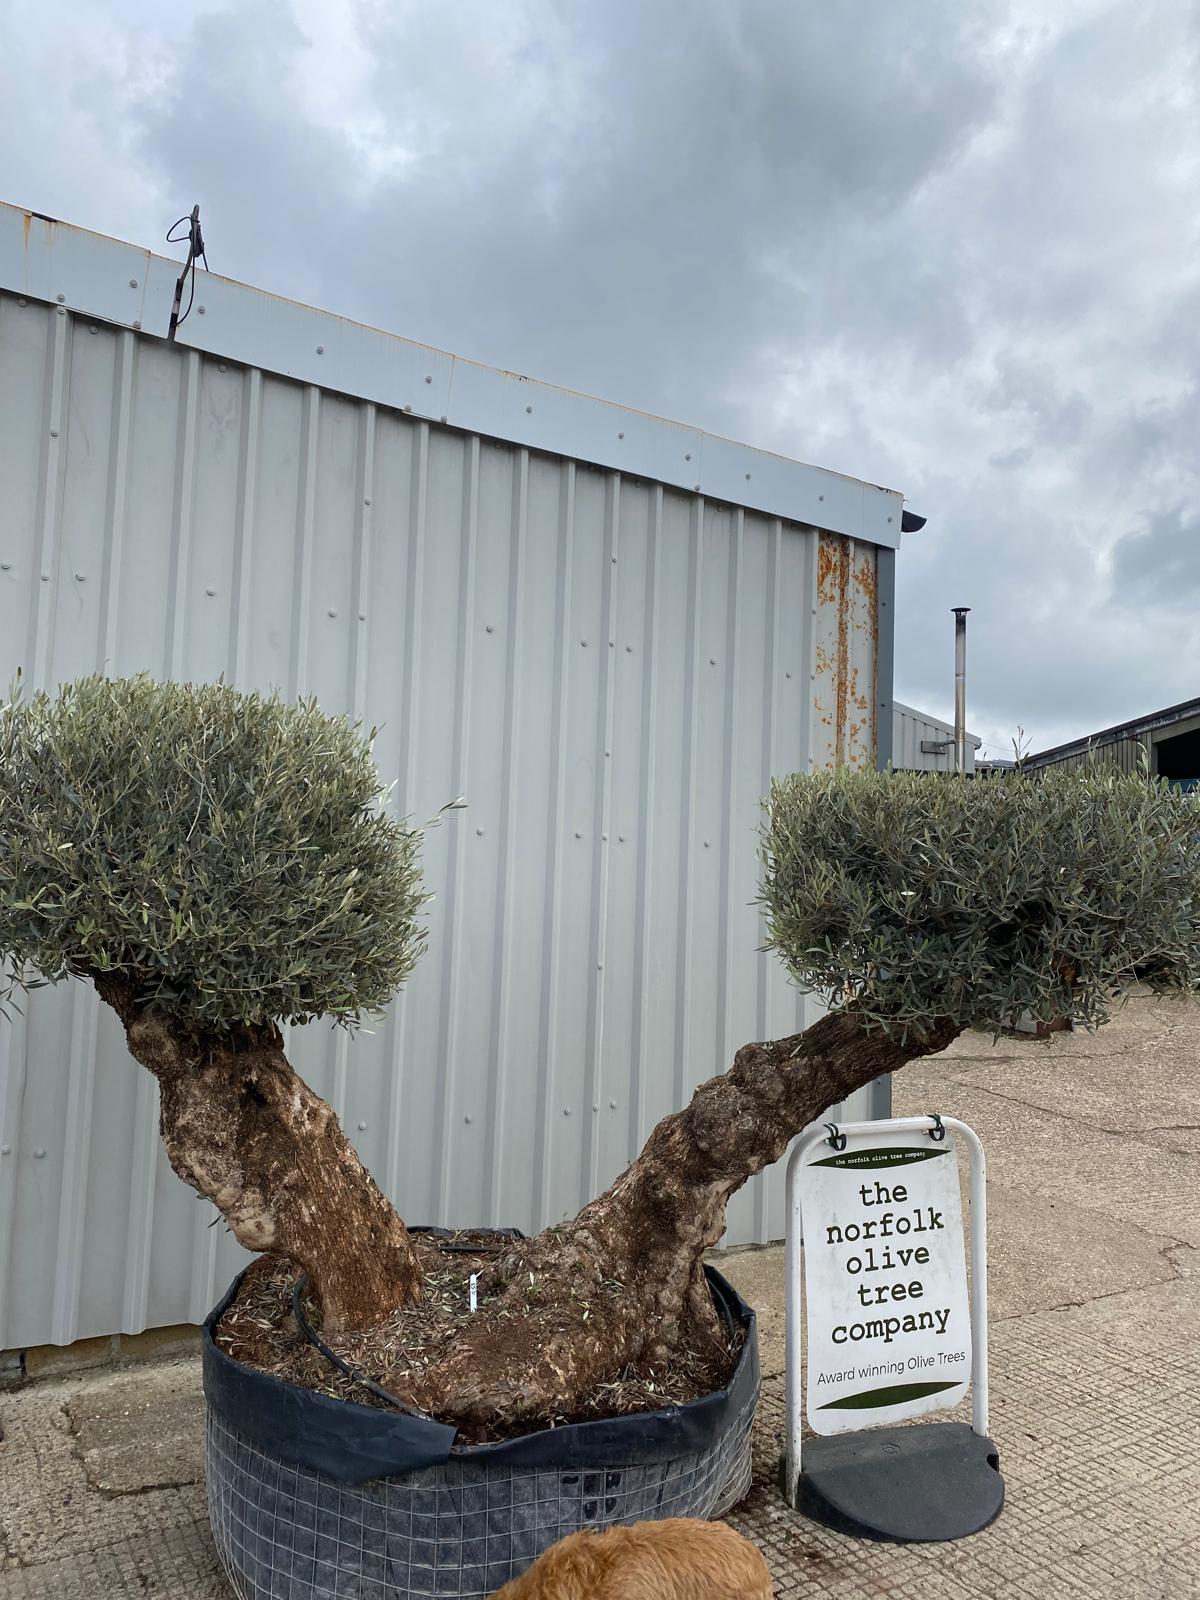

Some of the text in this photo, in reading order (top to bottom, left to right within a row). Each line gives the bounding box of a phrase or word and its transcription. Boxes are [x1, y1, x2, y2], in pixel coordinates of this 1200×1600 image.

[859, 1181, 908, 1207] the
[826, 1207, 945, 1244] norfolk
[846, 1246, 930, 1275] olive
[857, 1280, 924, 1307] tree
[831, 1308, 950, 1343] company
[817, 1351, 966, 1386] Award winning Olive Trees
